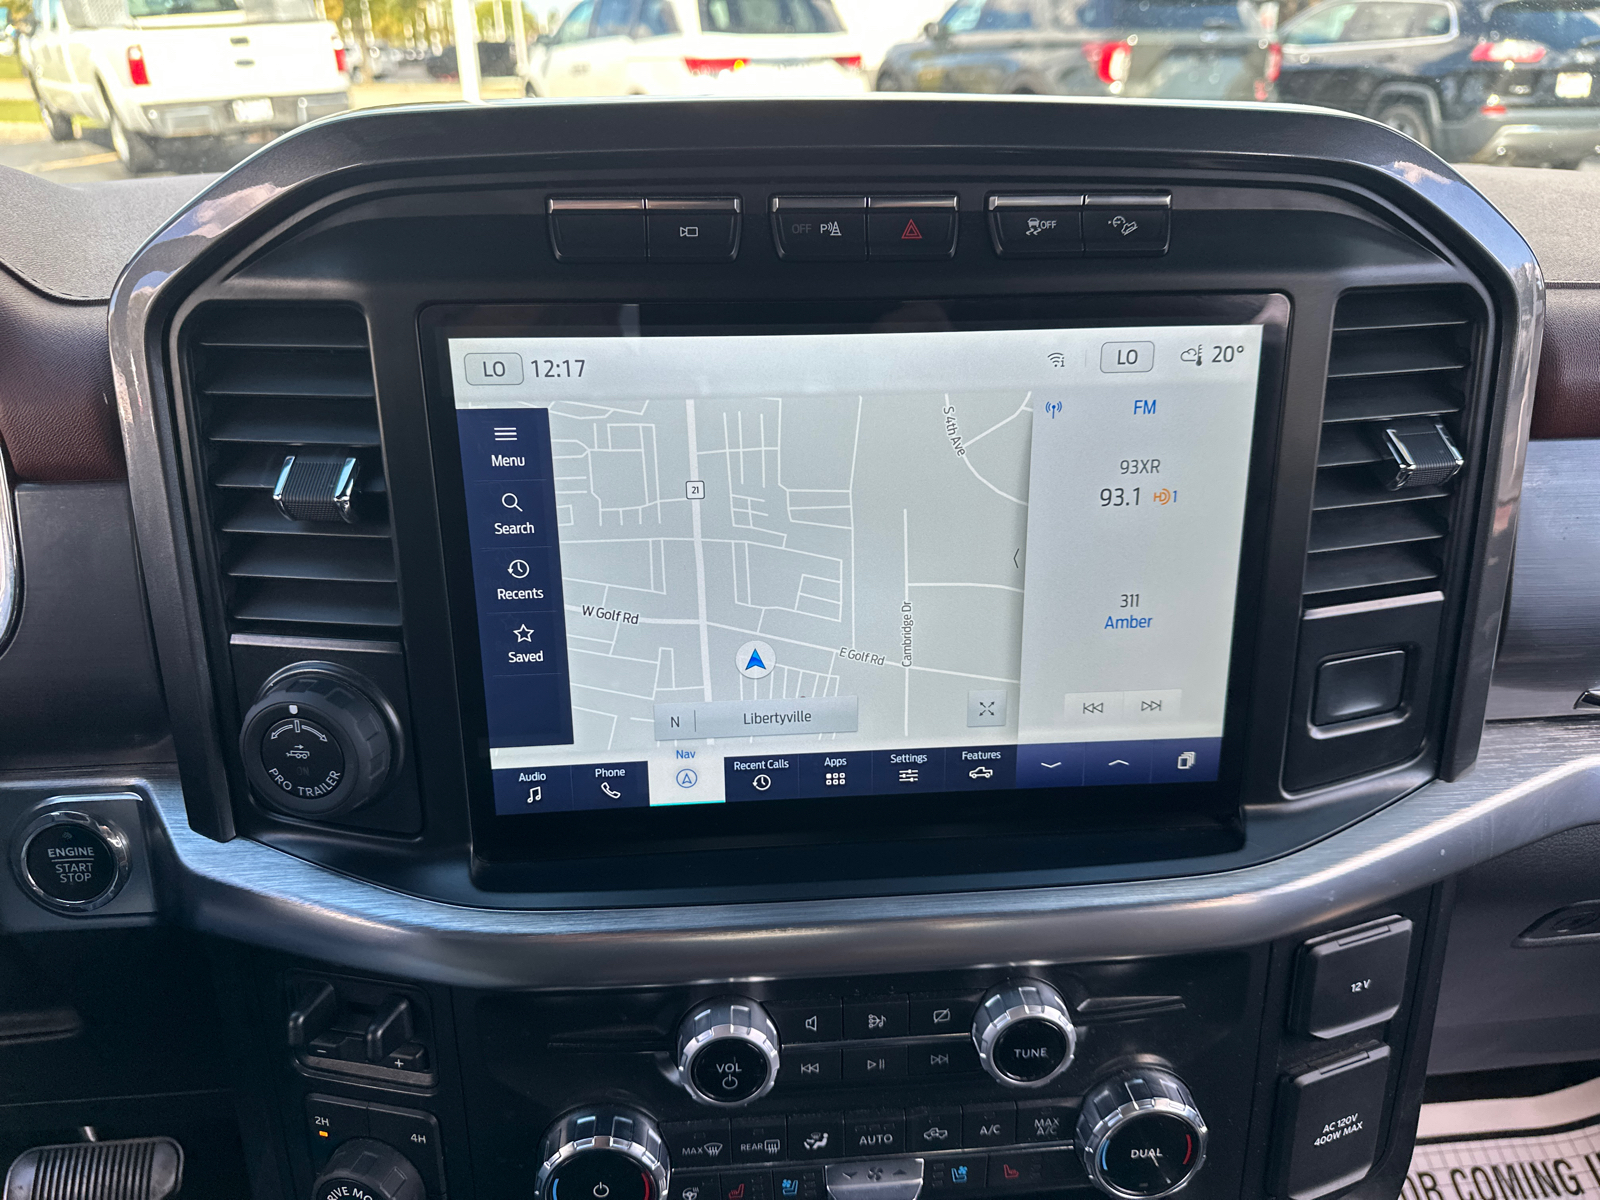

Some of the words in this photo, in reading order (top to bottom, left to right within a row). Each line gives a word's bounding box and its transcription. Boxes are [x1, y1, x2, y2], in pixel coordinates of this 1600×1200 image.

[1040, 219, 1057, 230] OFF
[1117, 349, 1139, 365] LO
[1211, 345, 1245, 364] 20°
[483, 360, 506, 378] LO
[531, 358, 586, 379] 12:17
[943, 406, 955, 415] S
[1133, 399, 1157, 415] FM
[945, 416, 958, 436] 4th
[950, 436, 966, 457] Ave
[491, 454, 526, 467] Menu
[1120, 459, 1161, 475] 93XR
[691, 485, 700, 495] 21
[1100, 486, 1140, 507] 93.1
[494, 521, 535, 535] Search
[497, 587, 545, 601] Recents
[901, 601, 912, 613] Dr
[1120, 593, 1140, 609] 311
[582, 604, 595, 617] W
[596, 607, 622, 622] Golf
[622, 612, 640, 625] Rd
[1104, 615, 1153, 630] Amber
[901, 614, 914, 668] Cambridge
[508, 650, 544, 664] Saved
[839, 646, 848, 658] E
[847, 649, 871, 663] Golf
[870, 653, 886, 666] Rd
[670, 715, 680, 728] N
[743, 709, 812, 726] Libertyville
[675, 748, 697, 760] Nav
[890, 752, 928, 765] Settings
[961, 749, 1001, 761] Features
[733, 759, 766, 771] Recent
[766, 757, 789, 770] Calls
[824, 756, 847, 768] Apps
[518, 771, 547, 783] Audio
[595, 766, 626, 779] Phone
[268, 767, 293, 791] PRO
[297, 770, 341, 797] TRAILER
[47, 846, 95, 858] ENGINE
[55, 862, 93, 874] START
[59, 872, 92, 883] STOP
[1350, 981, 1363, 993] 12
[1363, 979, 1371, 990] V
[1014, 1047, 1048, 1059] TUNE
[716, 1063, 742, 1074] VOL
[314, 1115, 330, 1127] 2H
[1034, 1117, 1060, 1128] MAX
[1322, 1121, 1336, 1133] AC
[1336, 1112, 1359, 1128] 120V
[979, 1125, 1001, 1136] A/C
[1036, 1125, 1058, 1136] A/C
[1313, 1129, 1342, 1146] 400W
[1342, 1120, 1364, 1136] MAX
[410, 1133, 427, 1144] 4H
[859, 1133, 893, 1146] AUTO
[682, 1146, 703, 1156] MAX
[740, 1142, 763, 1152] REAR
[1131, 1147, 1163, 1159] DUAL
[1450, 1158, 1585, 1200] COMING
[326, 1186, 350, 1200] RIVE
